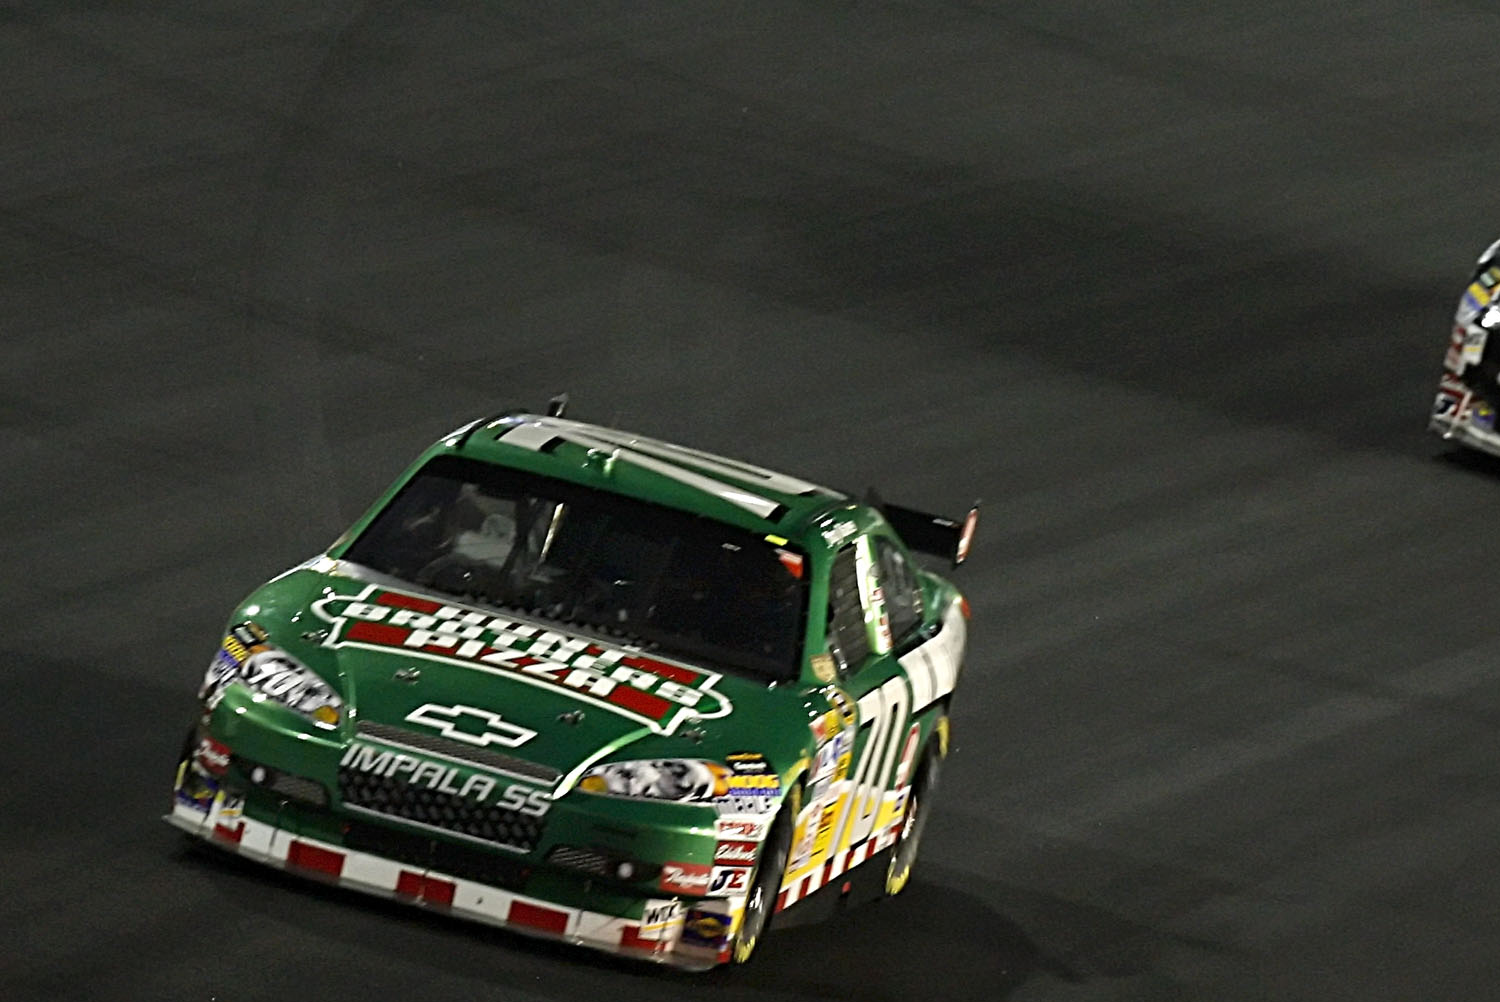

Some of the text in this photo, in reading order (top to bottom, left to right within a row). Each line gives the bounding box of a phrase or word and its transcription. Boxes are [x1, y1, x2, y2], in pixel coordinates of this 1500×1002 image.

[340, 602, 705, 708] BROTHERS
[403, 628, 618, 698] PIZZA
[339, 743, 553, 816] IMPALA SS
